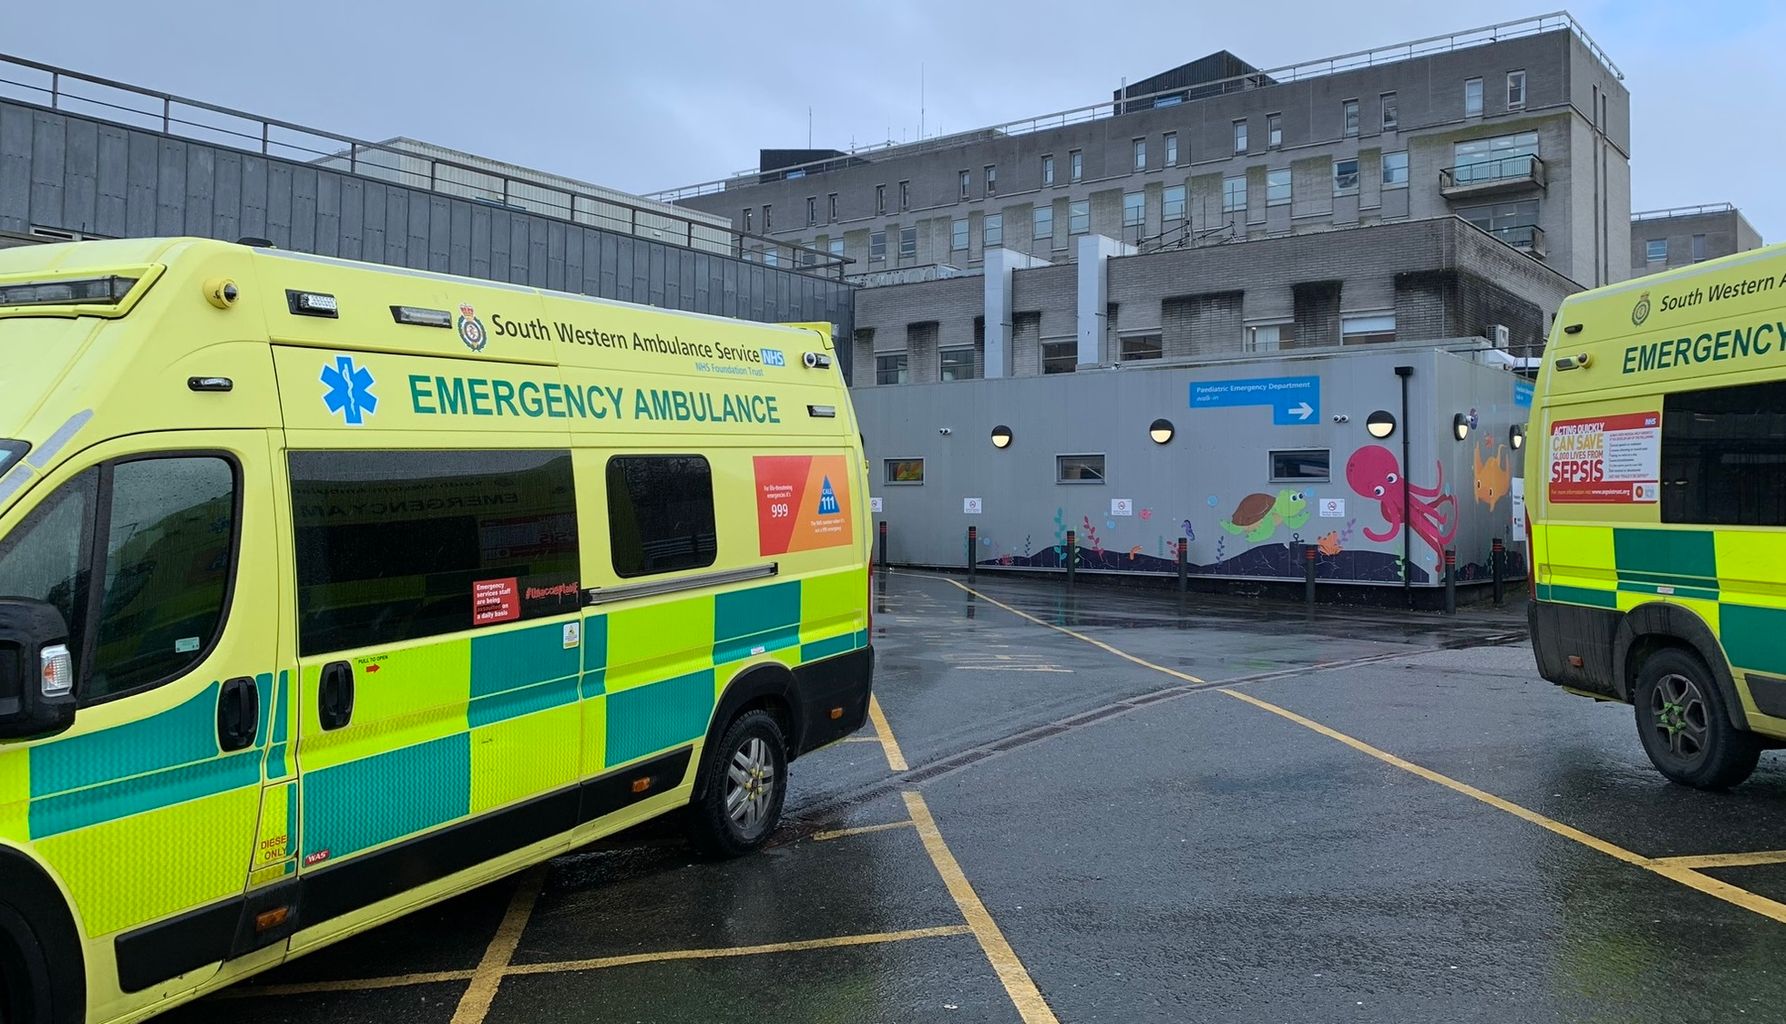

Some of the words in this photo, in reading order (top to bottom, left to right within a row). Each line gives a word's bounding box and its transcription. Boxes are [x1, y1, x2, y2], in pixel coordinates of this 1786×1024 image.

[1660, 287, 1703, 312] South
[1708, 275, 1775, 302] Western
[492, 313, 551, 341] South
[554, 321, 628, 350] Western
[632, 331, 713, 358] Ambulance
[715, 342, 761, 363] Service
[761, 349, 784, 366] NHS
[695, 362, 710, 373] NHS
[711, 364, 747, 375] Foundation
[748, 366, 764, 377] Trust
[1196, 386, 1229, 394] Paediatric
[1230, 384, 1267, 393] Emergency
[1268, 382, 1311, 391] Department
[408, 374, 623, 420] EMERGENCY
[634, 388, 781, 424] AMBULANCE
[1554, 424, 1577, 436] ACTING
[1578, 422, 1605, 434] QUICKLY
[1645, 418, 1657, 426] NHS
[1553, 435, 1574, 451] CAN
[1577, 433, 1604, 450] SAVE
[1570, 451, 1587, 460] LIVES
[1587, 450, 1604, 459] FROM
[1551, 459, 1604, 482] SEPSIS
[821, 496, 835, 511] 111
[771, 504, 788, 518] 999
[476, 583, 505, 591] Emergency
[476, 590, 498, 598] services
[486, 597, 501, 605] being
[481, 611, 494, 619] daily
[264, 846, 287, 861] ONLY
[308, 851, 327, 863] WAS
